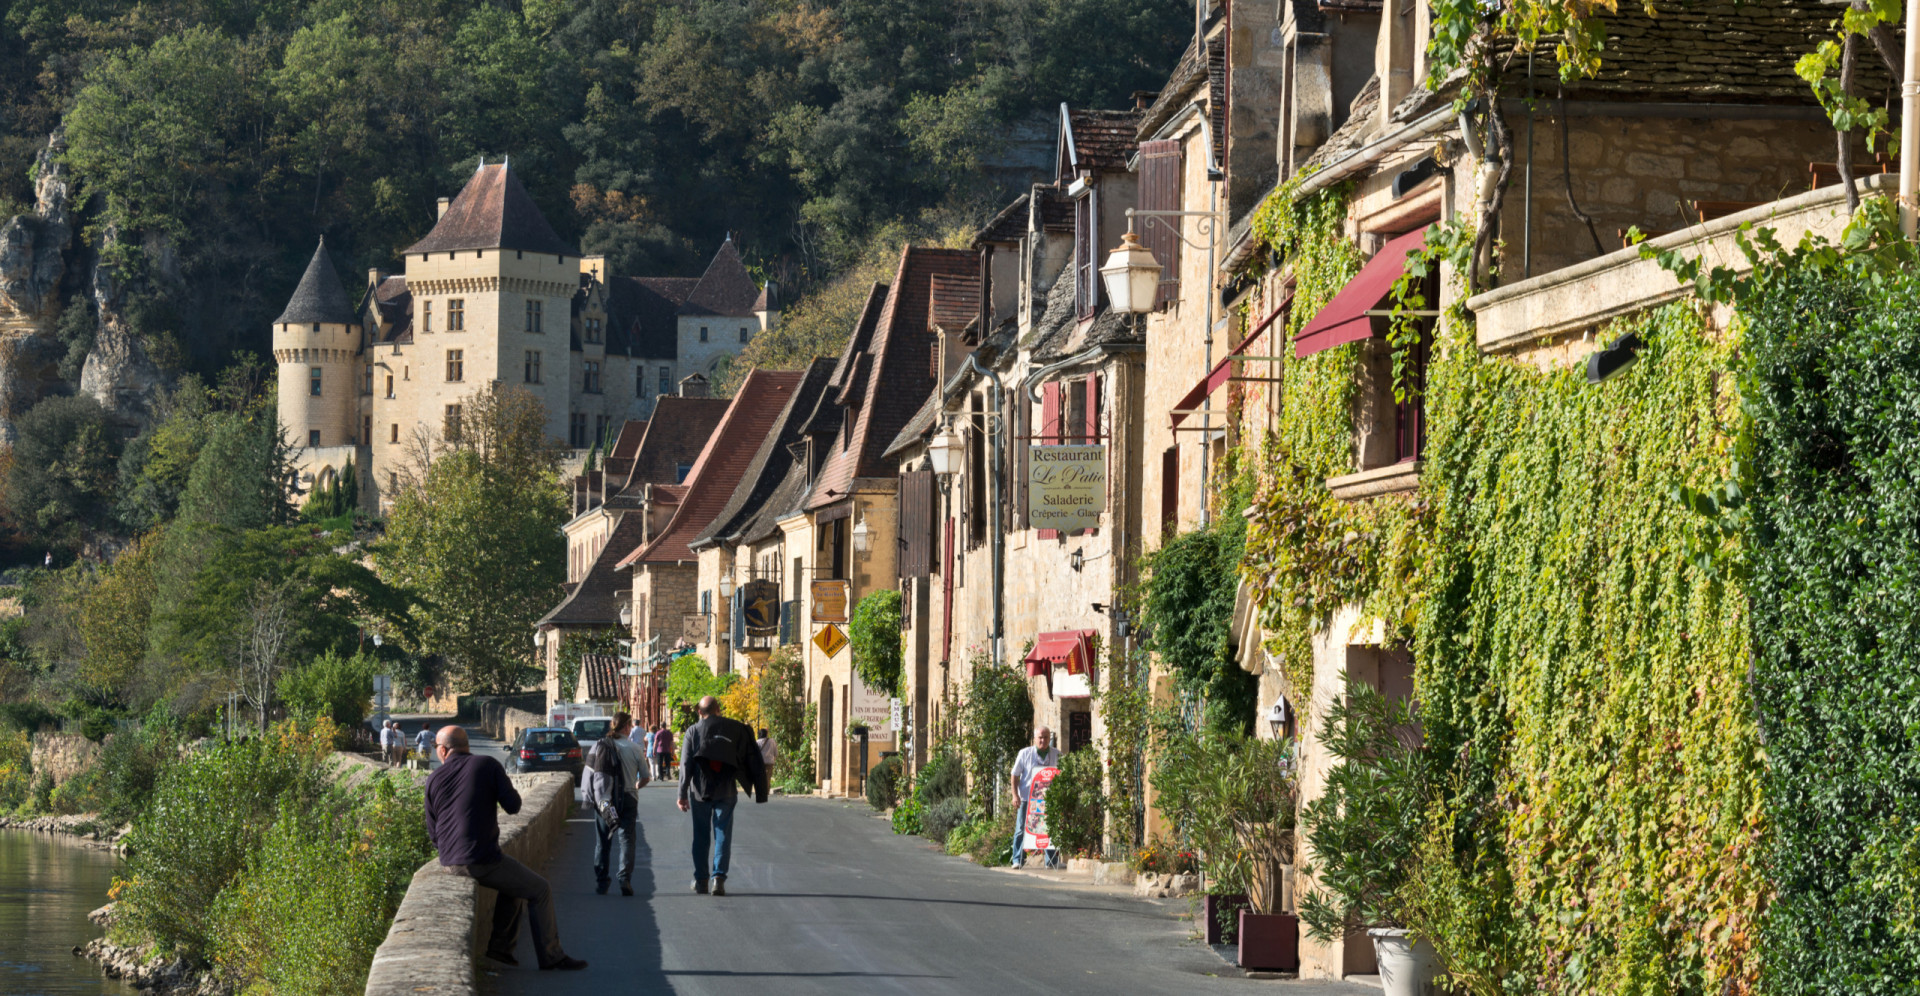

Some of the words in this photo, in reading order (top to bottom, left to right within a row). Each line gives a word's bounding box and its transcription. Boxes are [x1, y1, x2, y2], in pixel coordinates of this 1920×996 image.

[1033, 449, 1102, 462] Restaurant
[1031, 464, 1057, 485] Le
[1060, 464, 1105, 484] Patio
[1043, 494, 1094, 505] Saladerie
[1031, 509, 1068, 520] Crêperie
[827, 638, 844, 654] PRESSE
